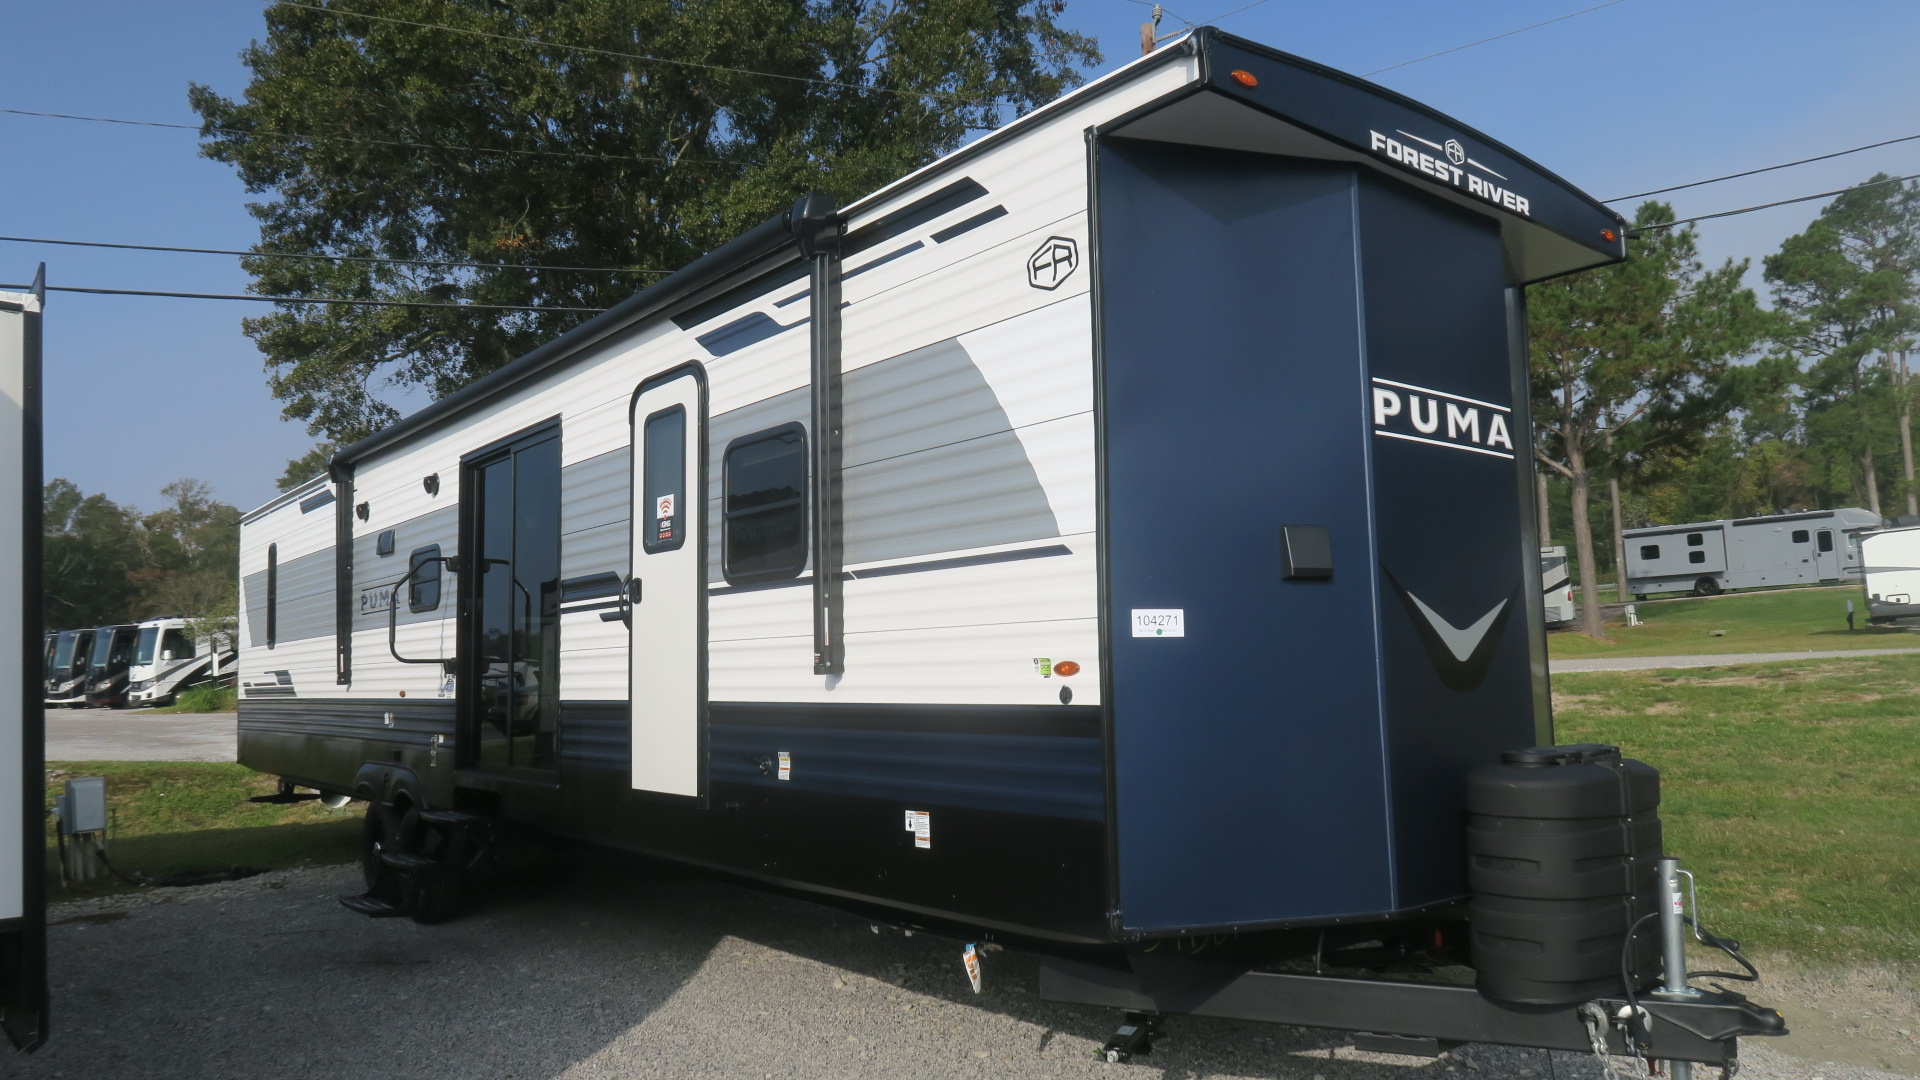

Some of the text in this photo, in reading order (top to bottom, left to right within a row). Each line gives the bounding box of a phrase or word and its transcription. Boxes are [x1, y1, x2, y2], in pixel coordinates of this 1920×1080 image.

[1370, 129, 1530, 216] FOREST RIVER
[1372, 386, 1513, 450] PUMA
[1136, 614, 1178, 626] 104271
